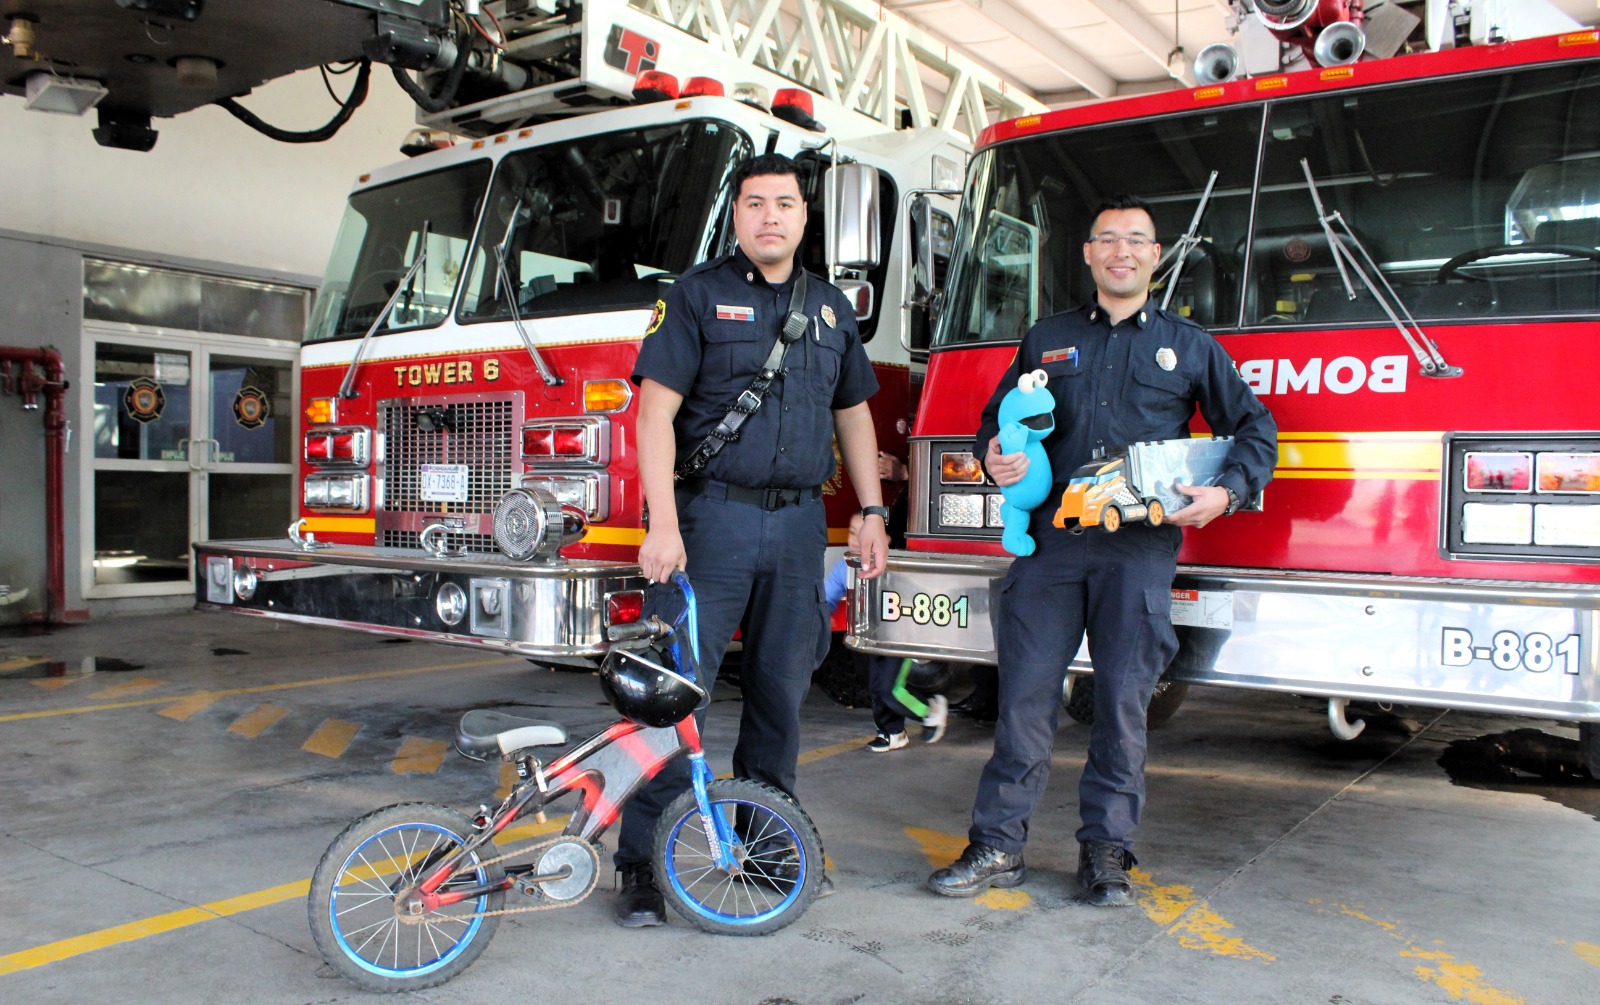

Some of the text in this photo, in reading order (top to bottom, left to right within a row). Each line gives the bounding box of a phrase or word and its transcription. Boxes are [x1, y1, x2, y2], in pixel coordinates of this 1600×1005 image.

[394, 358, 500, 387] TOWER 6
[881, 590, 969, 628] B-881
[1441, 626, 1581, 675] B-881
